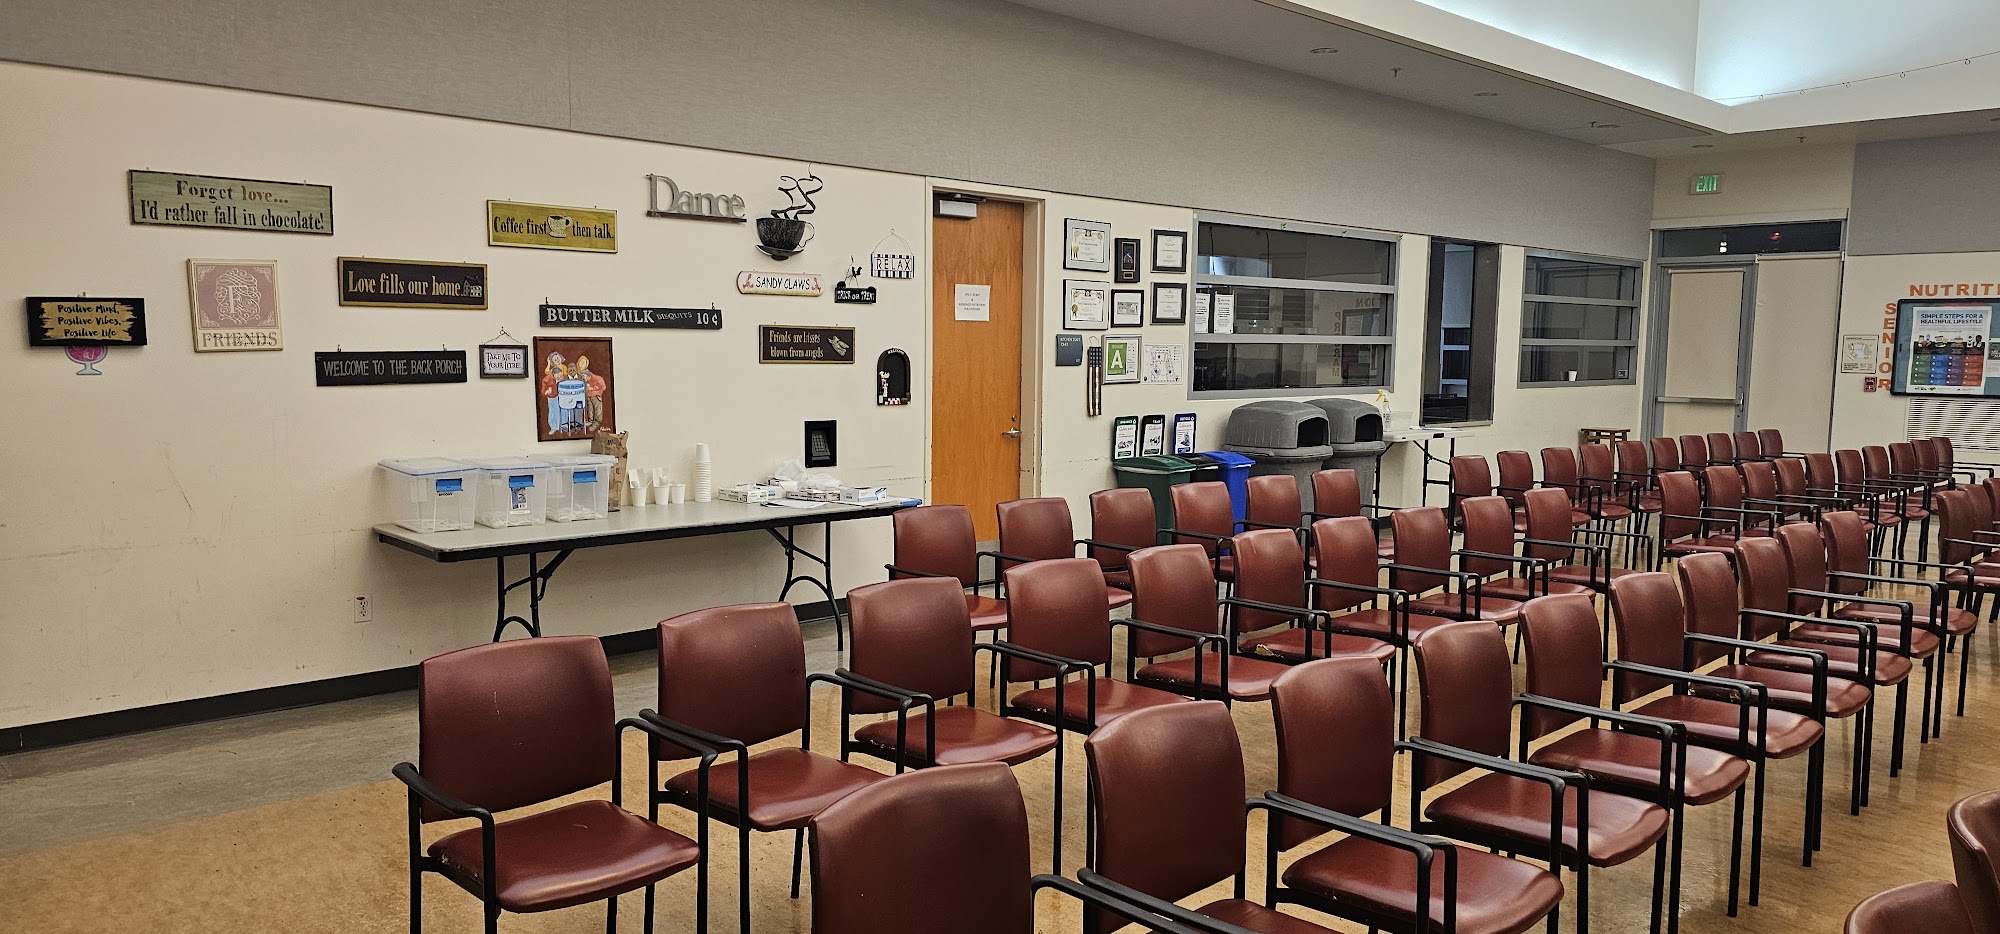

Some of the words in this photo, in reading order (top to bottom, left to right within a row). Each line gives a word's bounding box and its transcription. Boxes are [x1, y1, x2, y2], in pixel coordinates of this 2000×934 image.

[1696, 175, 1719, 192] EXIT
[176, 180, 233, 203] Forget
[241, 185, 289, 203] love...
[646, 173, 746, 217] Dance
[140, 200, 158, 220] I'd
[165, 203, 208, 223] rather
[213, 205, 237, 225] fall
[243, 208, 256, 226] in
[261, 208, 324, 230] chocolate!
[493, 216, 524, 234] Coffee
[526, 218, 548, 235] first
[572, 222, 591, 238] then
[594, 223, 615, 239] talk.
[876, 258, 911, 271] RELAX
[348, 270, 376, 294] Love
[380, 272, 405, 295] fills
[408, 280, 429, 295] our
[431, 275, 464, 297] home.
[755, 276, 782, 289] SANDY
[784, 278, 811, 291] CLAWS
[838, 290, 851, 300] TRICK
[861, 290, 875, 300] TREAT
[57, 303, 94, 313] Positive
[95, 302, 120, 315] Mind,
[57, 315, 93, 326] Positive
[546, 308, 612, 323] BUTTER
[614, 309, 655, 324] MILK
[696, 312, 709, 325] 10
[64, 328, 100, 338] Positive
[202, 332, 278, 347] FRIENDS
[769, 330, 791, 343] Friends
[793, 334, 802, 343] are
[803, 331, 821, 344] kisses
[770, 345, 788, 358] blown
[789, 346, 804, 358] from
[805, 346, 824, 360] angels
[1878, 303, 1897, 391] SENIOR
[485, 352, 501, 361] TAKE
[502, 353, 510, 361] ME
[511, 352, 521, 361] TO
[1110, 349, 1124, 369] A
[323, 360, 369, 377] WELCOME
[372, 359, 385, 376] TO
[389, 359, 408, 376] THE
[411, 359, 433, 376] BACK
[435, 359, 462, 375] PORCH
[487, 360, 504, 370] YOUR
